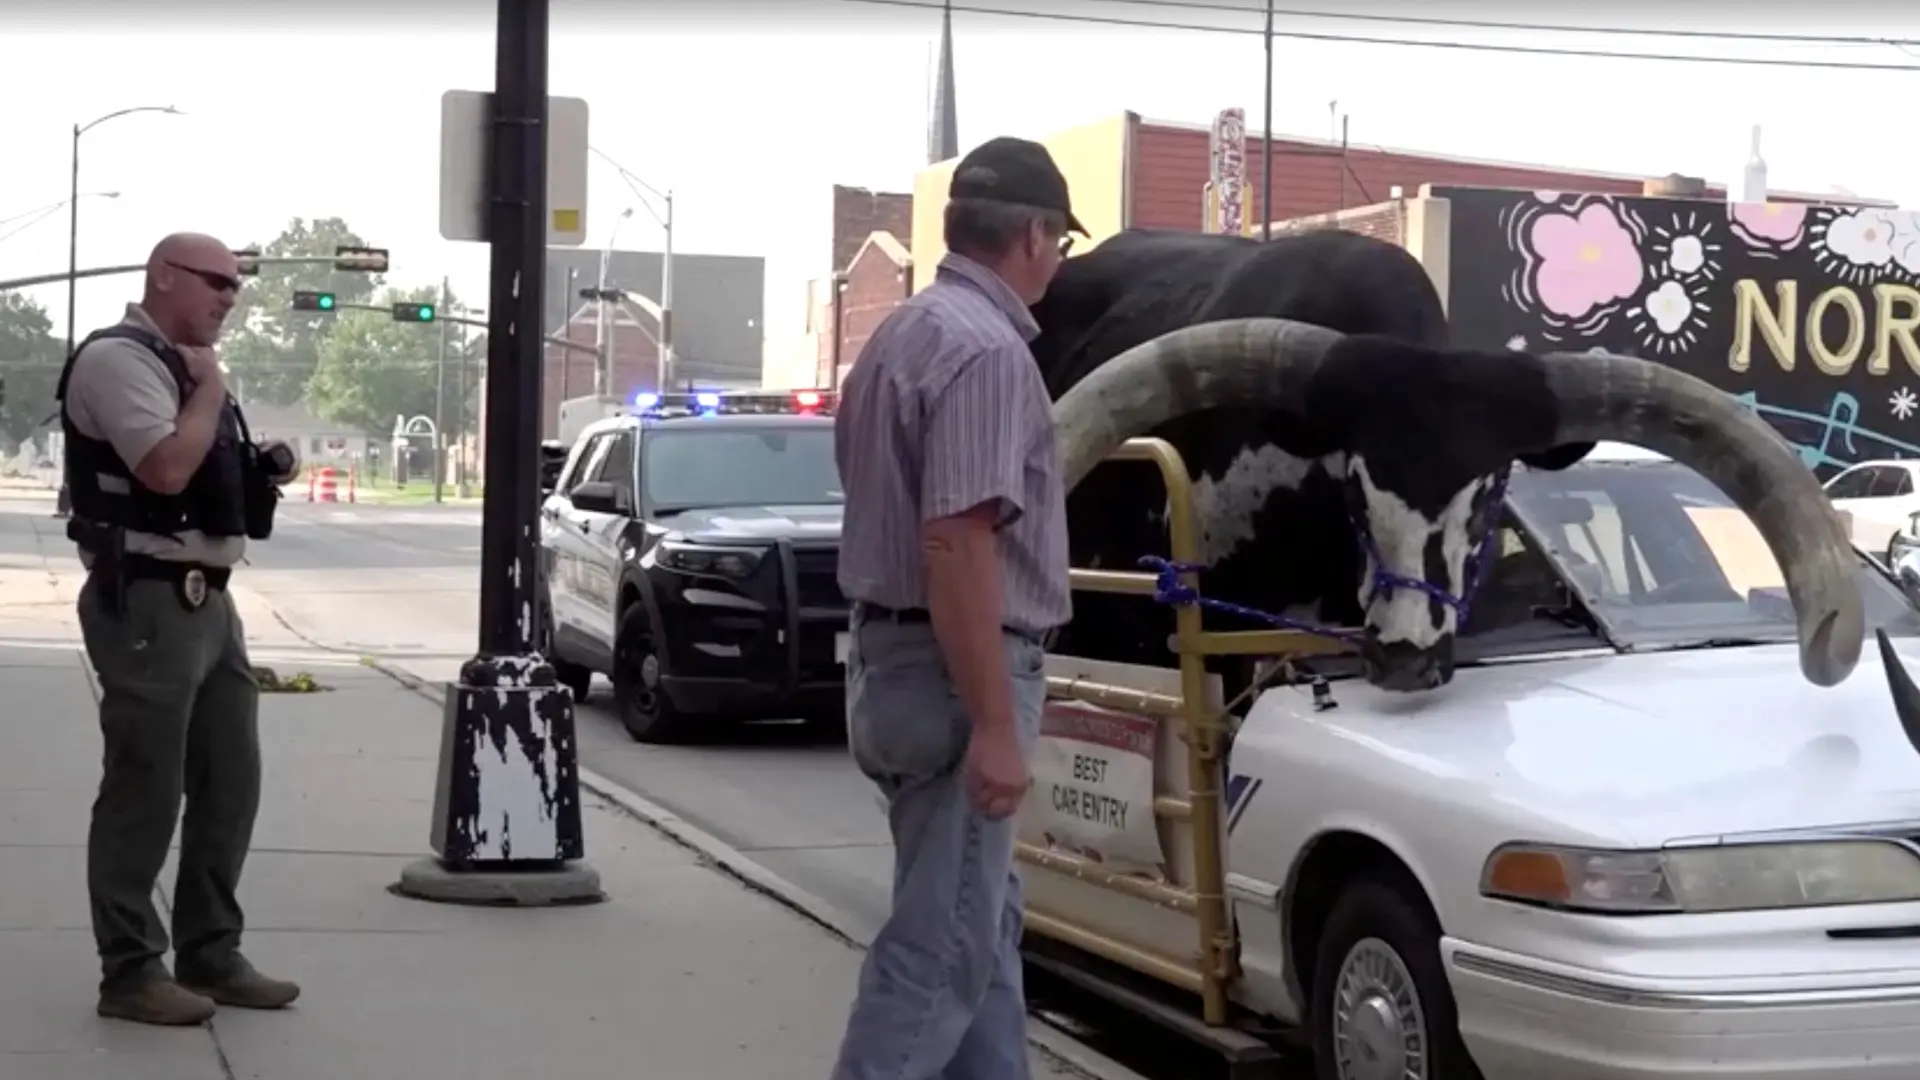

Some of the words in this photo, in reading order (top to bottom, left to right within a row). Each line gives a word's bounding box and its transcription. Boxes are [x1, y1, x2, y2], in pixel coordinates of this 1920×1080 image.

[1728, 279, 1920, 375] NOR
[1073, 755, 1108, 783] BEST
[1052, 784, 1080, 818] CAR
[1083, 790, 1128, 830] ENTRY
